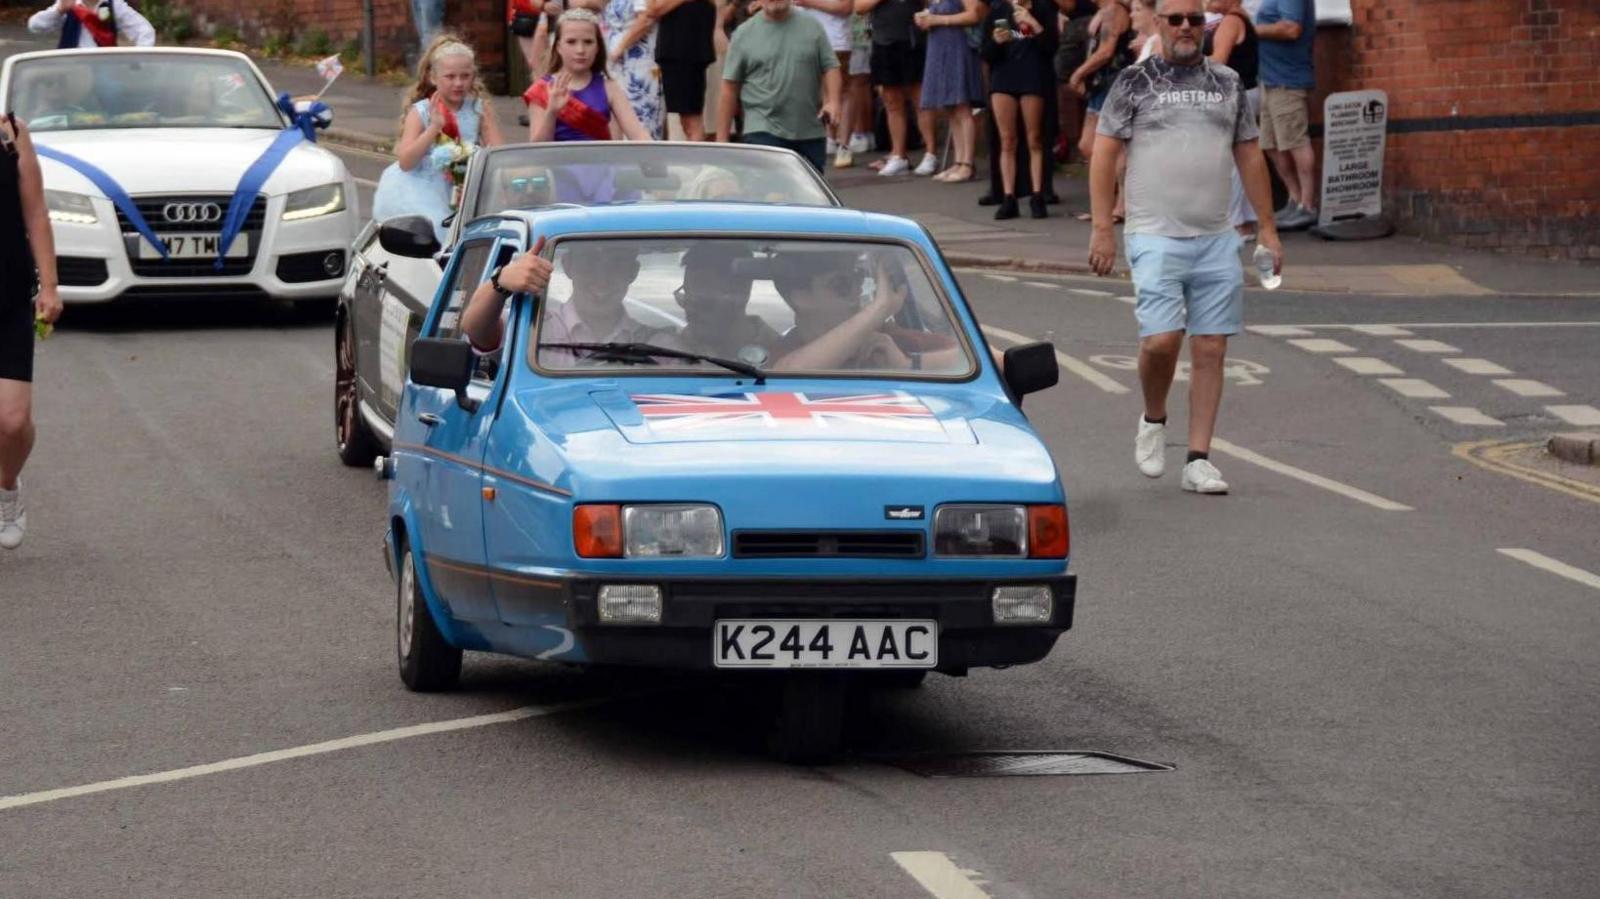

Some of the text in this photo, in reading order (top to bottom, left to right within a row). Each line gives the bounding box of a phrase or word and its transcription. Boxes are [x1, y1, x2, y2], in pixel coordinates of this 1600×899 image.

[1159, 90, 1222, 104] FIRETRAP
[1339, 161, 1368, 172] LARGE
[1327, 170, 1378, 184] BATHROOM
[1326, 180, 1379, 194] SHOWROOM
[191, 236, 221, 254] TM
[721, 625, 929, 659] K244 AAC
